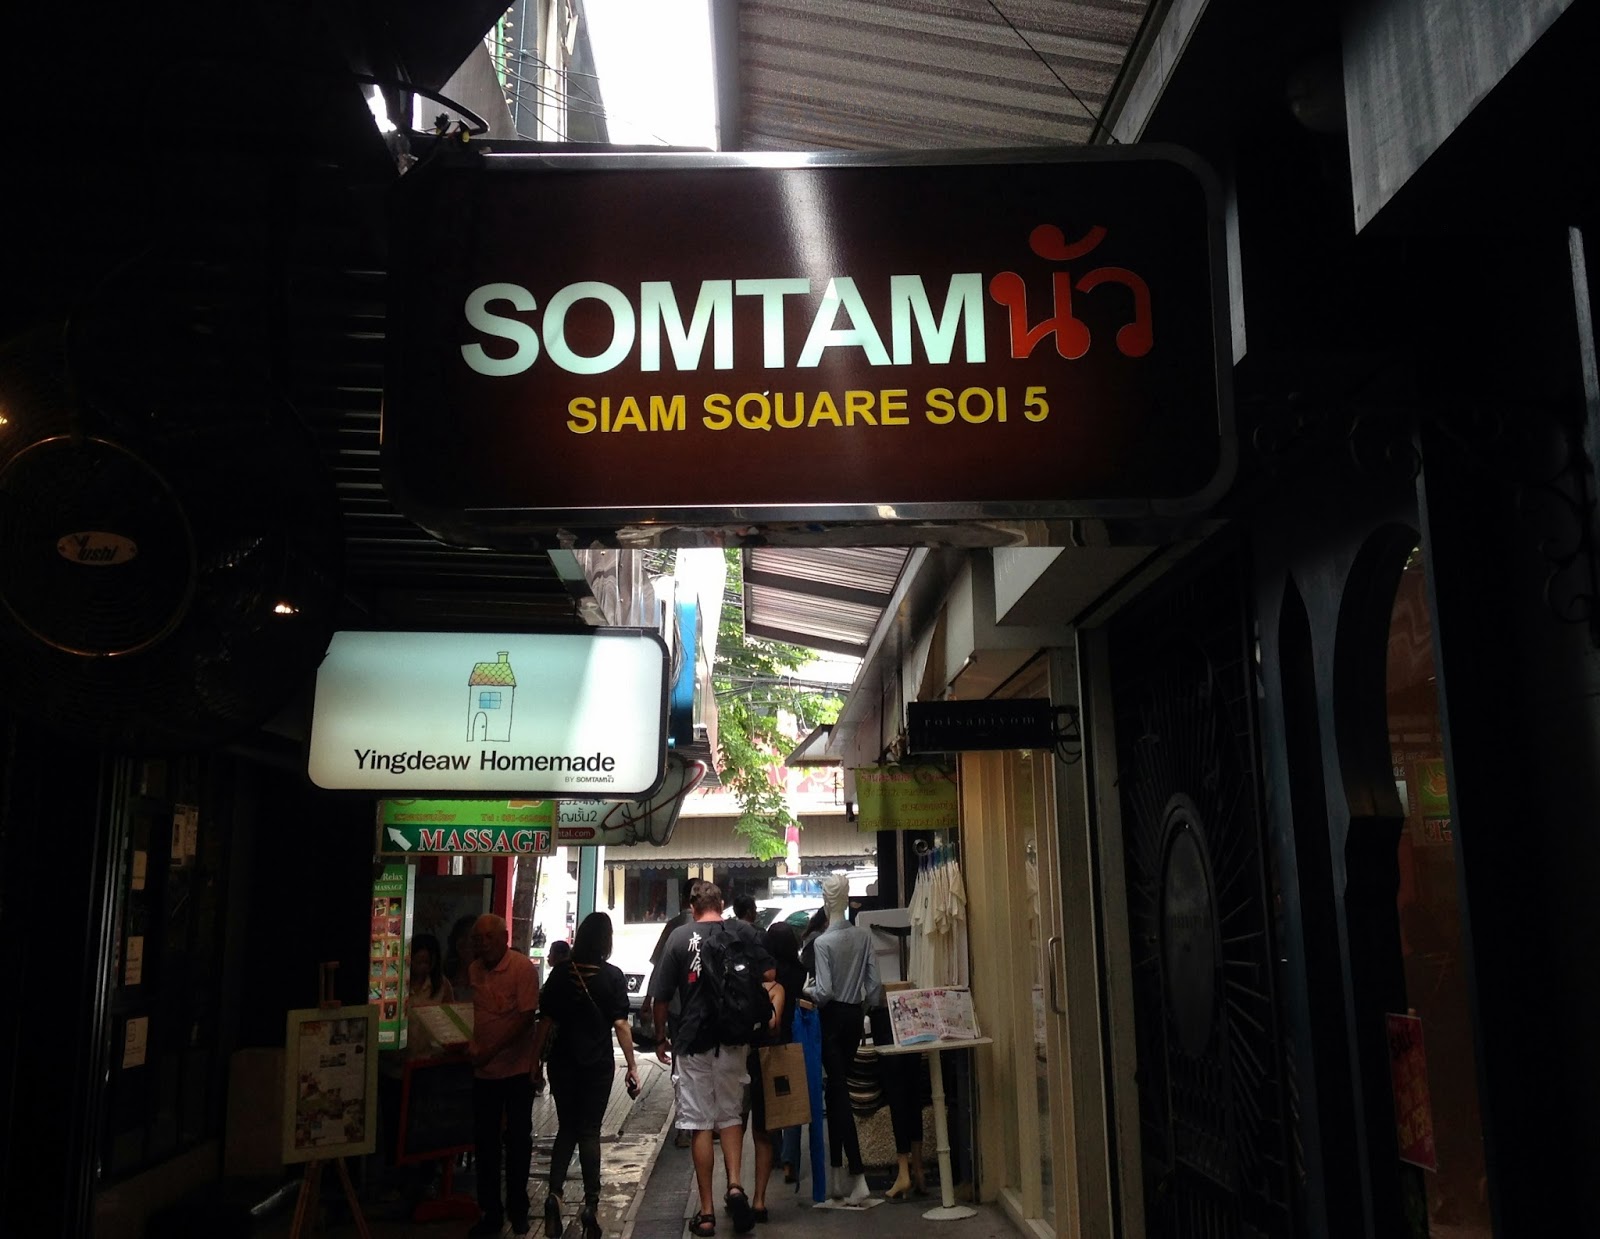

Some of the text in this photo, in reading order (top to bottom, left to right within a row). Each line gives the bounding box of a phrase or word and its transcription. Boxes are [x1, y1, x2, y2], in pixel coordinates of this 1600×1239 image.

[566, 386, 1050, 434] SIAM SQUARE SOI 5
[354, 749, 615, 774] Yingdeaw Homemade
[418, 828, 550, 852] MASSAGE
